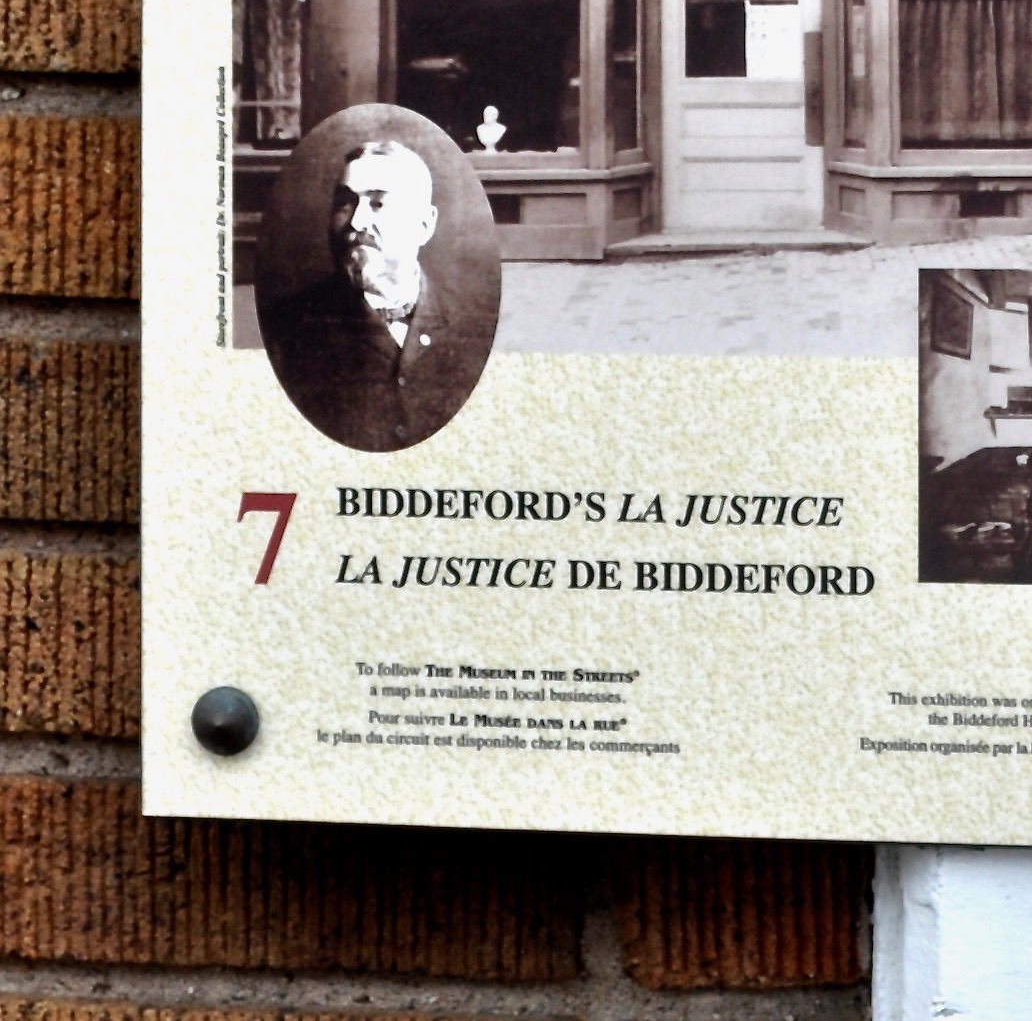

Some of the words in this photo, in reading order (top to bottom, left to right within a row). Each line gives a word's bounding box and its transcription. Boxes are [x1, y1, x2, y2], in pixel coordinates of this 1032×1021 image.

[335, 487, 606, 523] BIDDEFORD'S
[617, 493, 667, 524] LA
[675, 494, 844, 527] JUSTICE
[237, 491, 298, 586] 7
[335, 554, 383, 585] LA
[392, 556, 557, 589] JUSTICE
[567, 559, 622, 590] DE
[632, 560, 875, 598] BIDDEFORD
[355, 662, 374, 676] To
[377, 662, 421, 678] follow
[370, 685, 378, 696] a
[382, 686, 412, 701] map
[413, 684, 426, 697] is
[429, 685, 491, 700] available
[495, 687, 509, 701] in
[512, 687, 546, 702] local
[550, 688, 626, 704] businesses.
[887, 691, 918, 705] This
[921, 692, 988, 708] exhibition
[992, 695, 1017, 708] was
[368, 710, 401, 725] Pour
[402, 712, 445, 726] suivre
[928, 711, 948, 726] the
[953, 712, 1019, 728] Biddeford
[317, 729, 330, 743] le
[332, 729, 362, 747] plan
[366, 731, 384, 744] du
[386, 731, 431, 746] circuit
[433, 735, 453, 747] est
[456, 733, 527, 751] disponible
[531, 736, 563, 750] chez
[567, 737, 585, 751] les
[589, 741, 681, 757] commerçants
[860, 738, 927, 754] Exposition
[993, 744, 1013, 757] par
[1016, 742, 1028, 754] la
